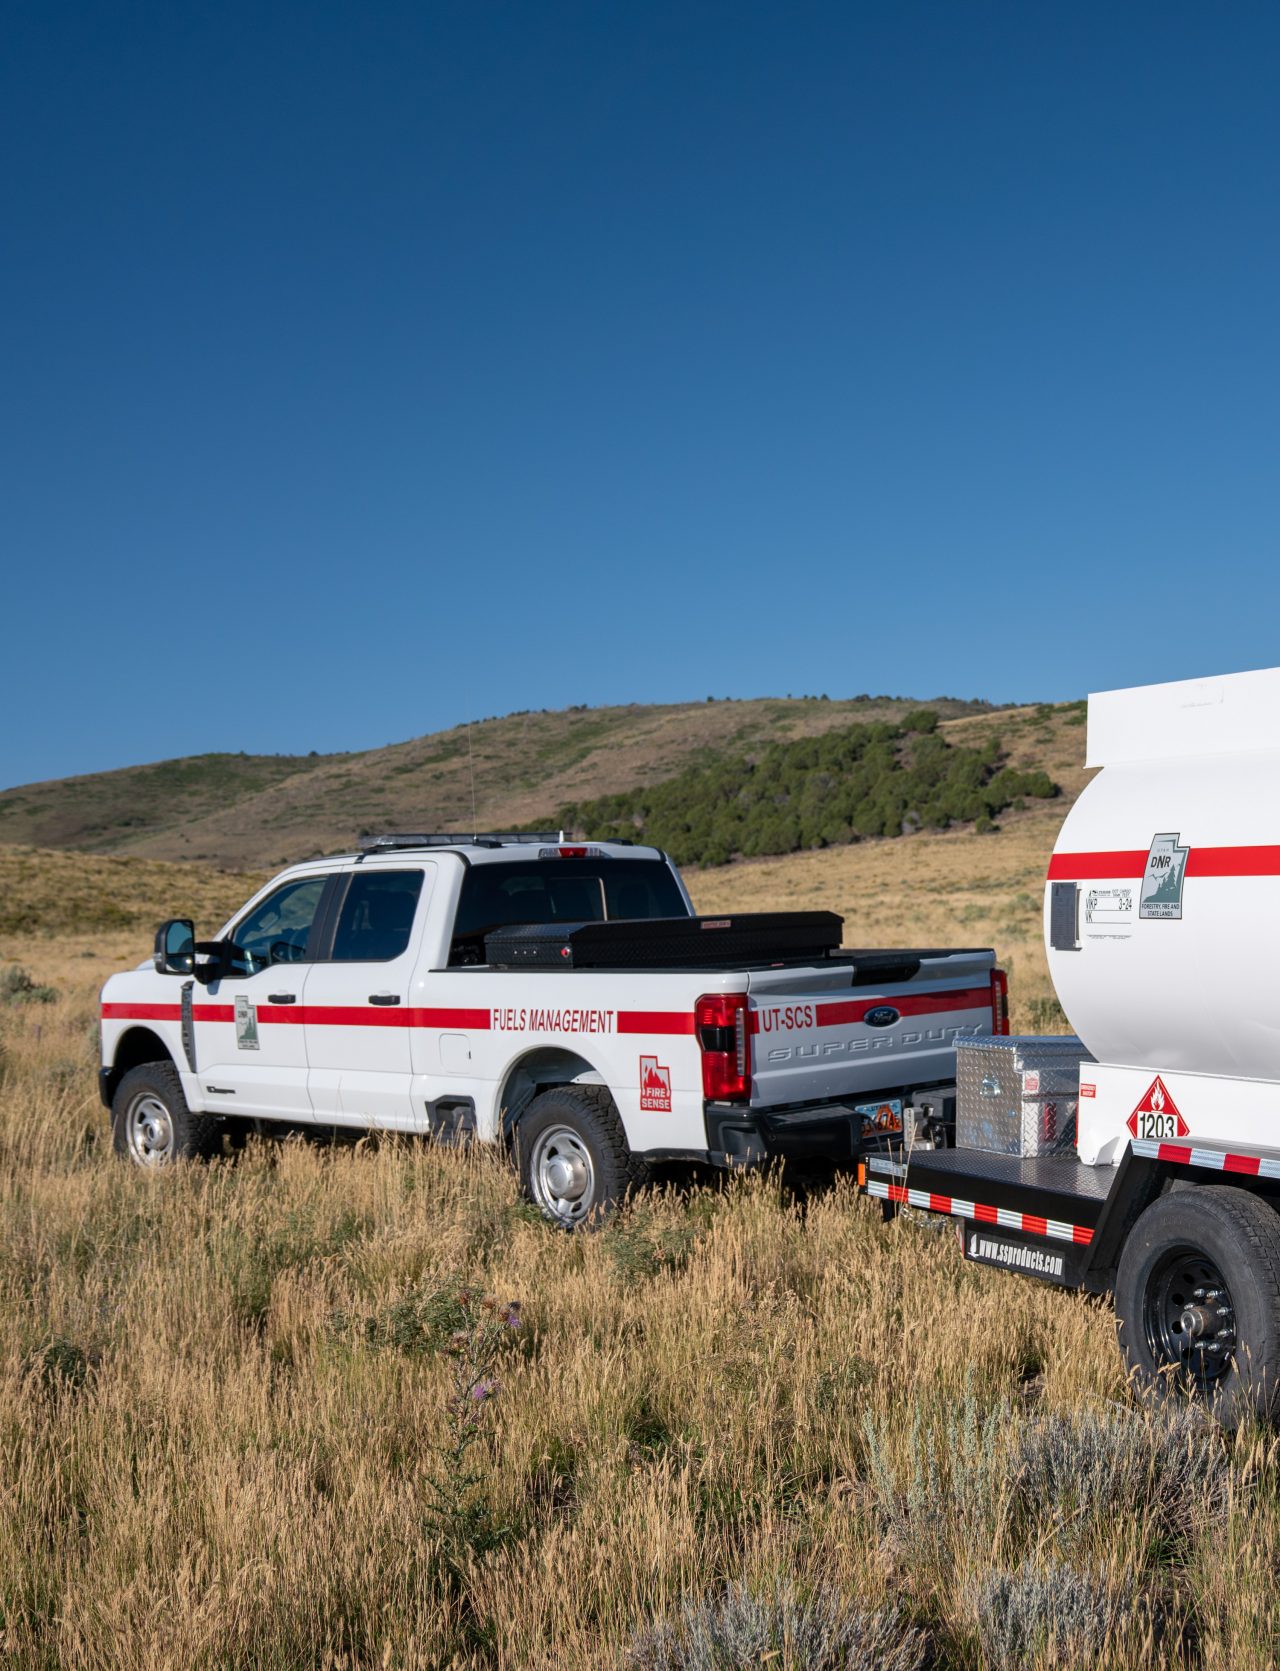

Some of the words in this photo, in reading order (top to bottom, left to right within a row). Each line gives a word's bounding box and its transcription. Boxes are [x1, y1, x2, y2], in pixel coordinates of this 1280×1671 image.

[1150, 855, 1171, 869] DNR
[493, 1008, 527, 1031] FUELS
[528, 1008, 614, 1033] MANAGEMENT
[761, 1005, 813, 1032] UT-SCS
[873, 1010, 894, 1023] Ford
[767, 1035, 894, 1063] SUPER
[902, 1023, 983, 1046] DUTY
[641, 1097, 670, 1109] SENSE
[646, 1087, 666, 1098] FIRE
[1139, 1112, 1175, 1139] 1203
[979, 1239, 1063, 1276] www.ssproducts.com
